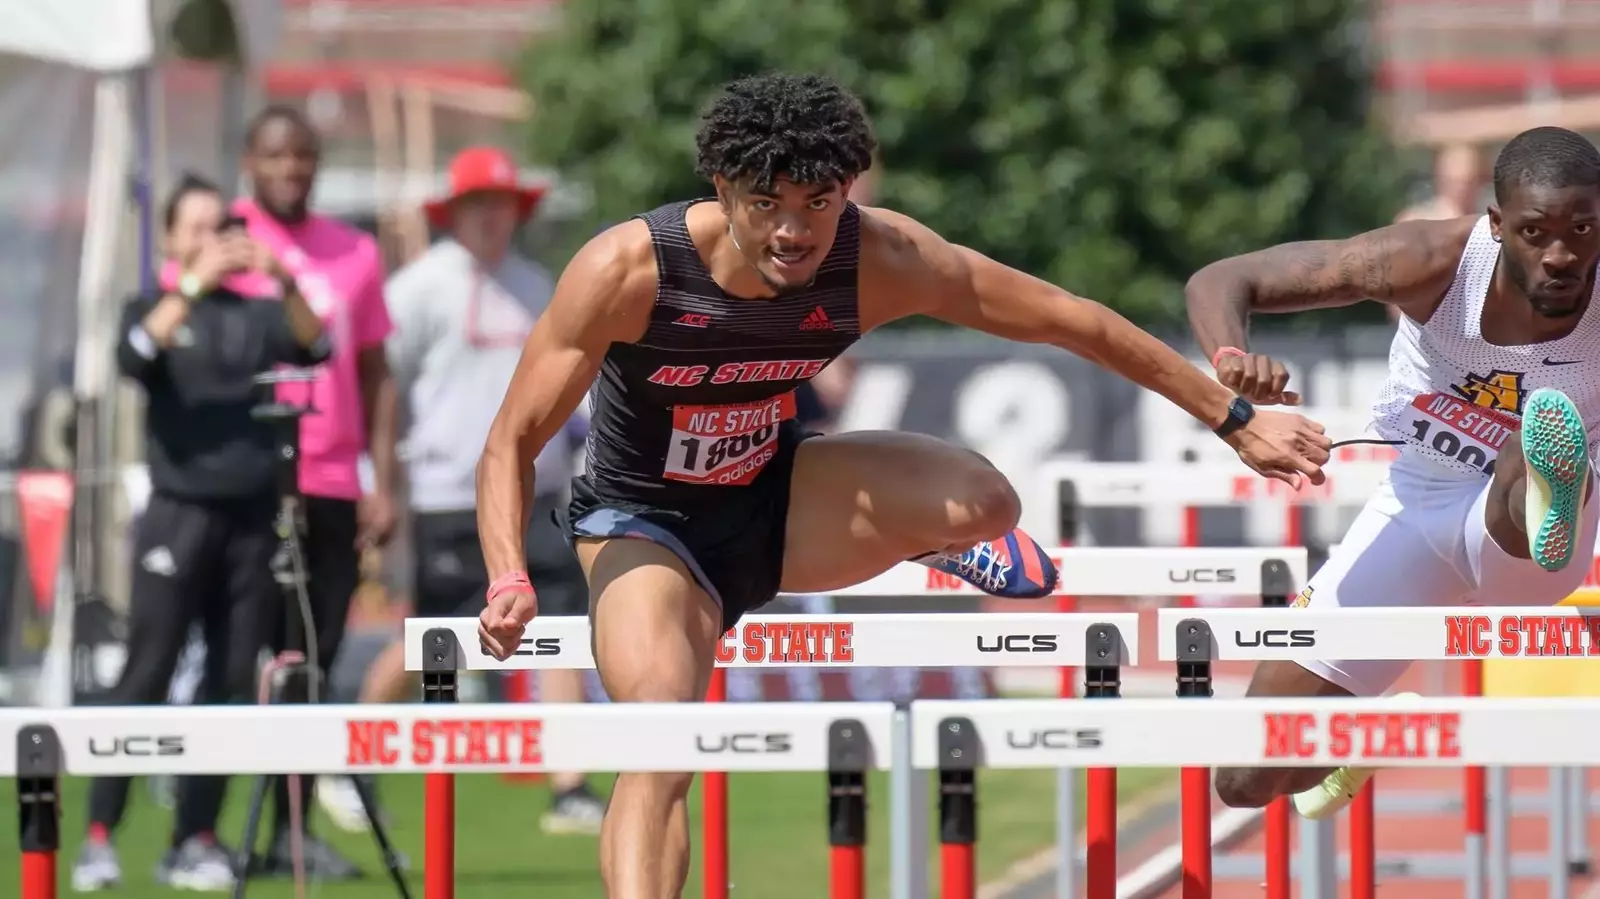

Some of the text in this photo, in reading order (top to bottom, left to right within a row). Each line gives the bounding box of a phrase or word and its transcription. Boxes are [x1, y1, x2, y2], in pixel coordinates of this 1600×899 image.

[648, 358, 829, 387] NC STATE
[688, 400, 782, 434] NC STATE
[1427, 395, 1463, 420] NC
[1458, 412, 1513, 448] STAT
[1412, 419, 1495, 475] 100
[718, 448, 773, 484] adidas
[1169, 568, 1236, 583] UCS
[743, 622, 854, 663] STATE
[977, 635, 1058, 652] UCS
[1235, 630, 1316, 647] UCS
[1445, 616, 1493, 656] NC
[88, 735, 186, 756] UCS
[346, 719, 543, 765] NC STATE
[696, 733, 793, 754] UCS
[1007, 729, 1103, 749] UCS
[1264, 713, 1462, 758] NC STATE
